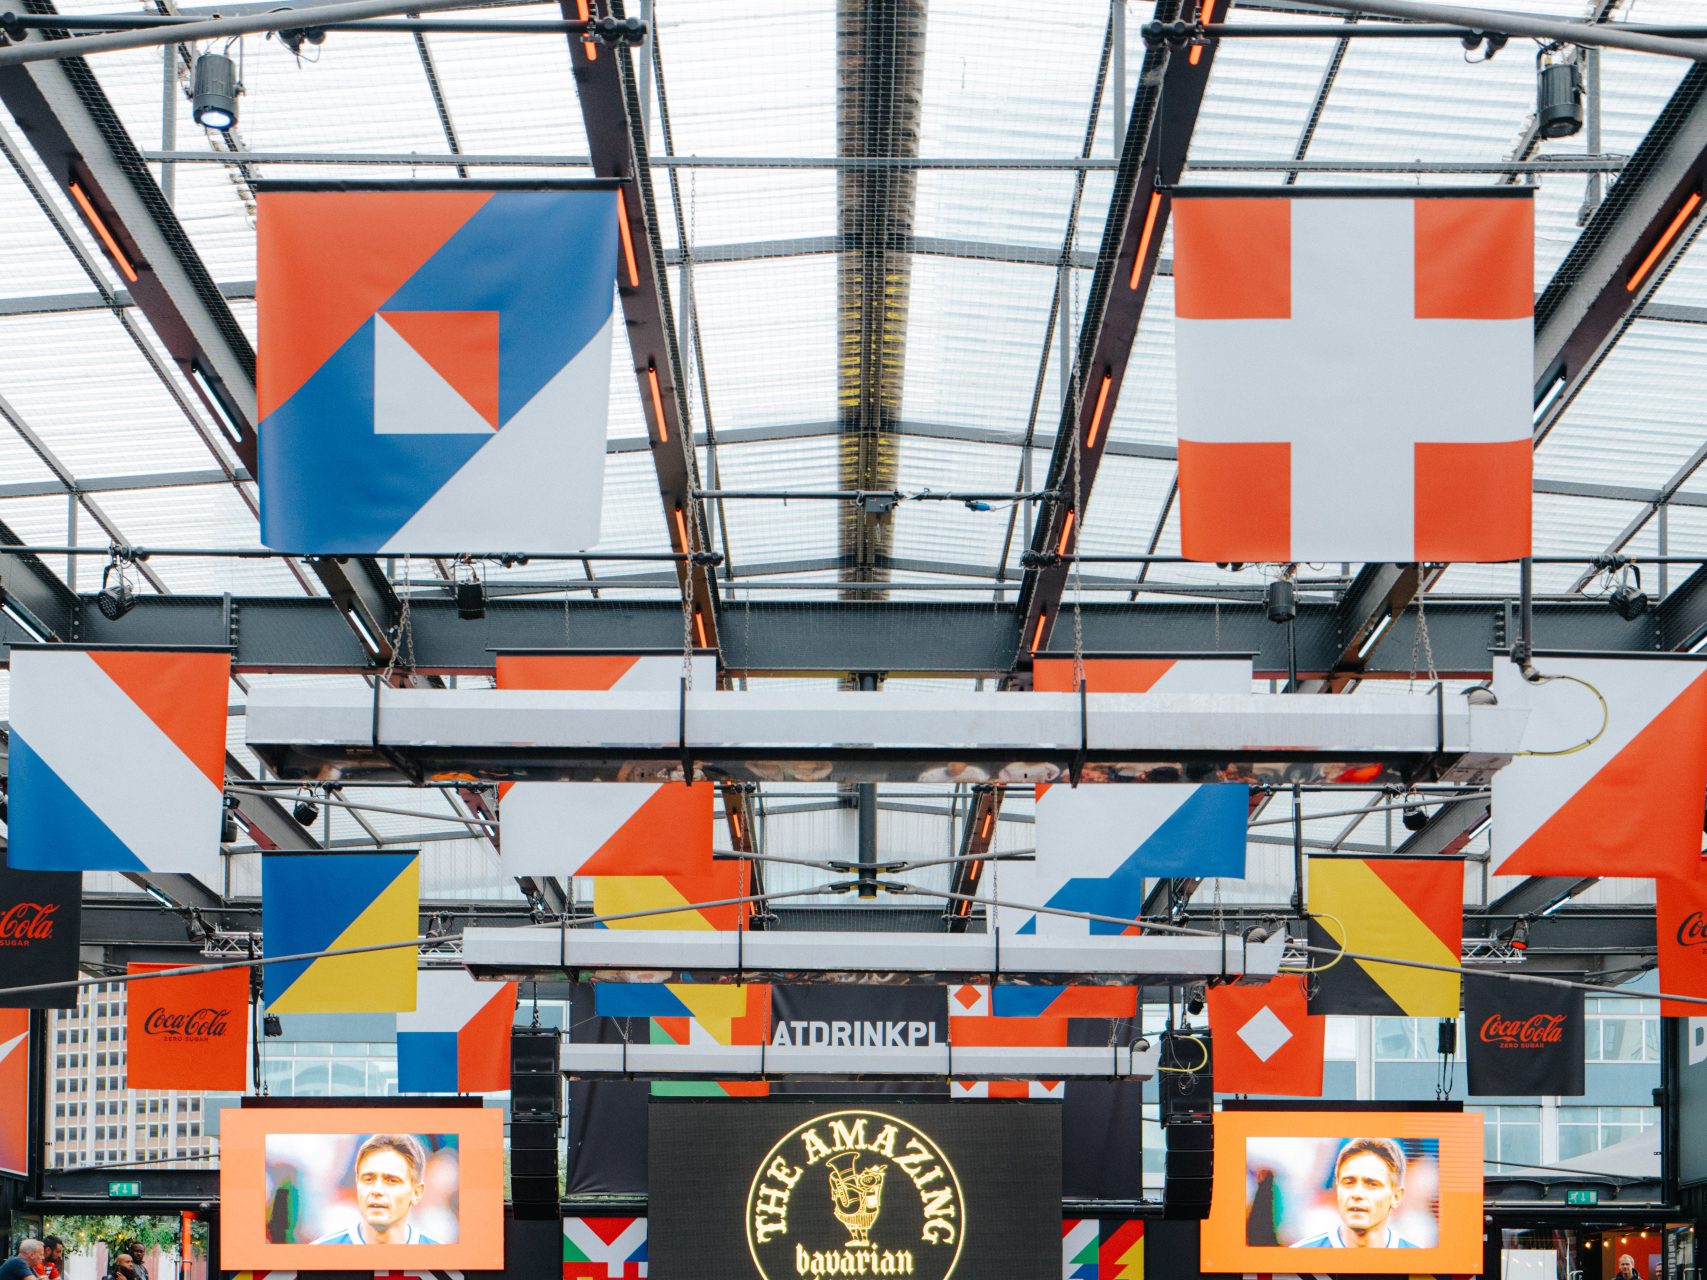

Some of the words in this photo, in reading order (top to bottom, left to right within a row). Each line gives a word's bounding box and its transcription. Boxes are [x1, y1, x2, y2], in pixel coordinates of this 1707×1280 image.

[755, 1155, 803, 1244] THE
[801, 1118, 956, 1246] AMAZING
[795, 1242, 914, 1276] bavarian
